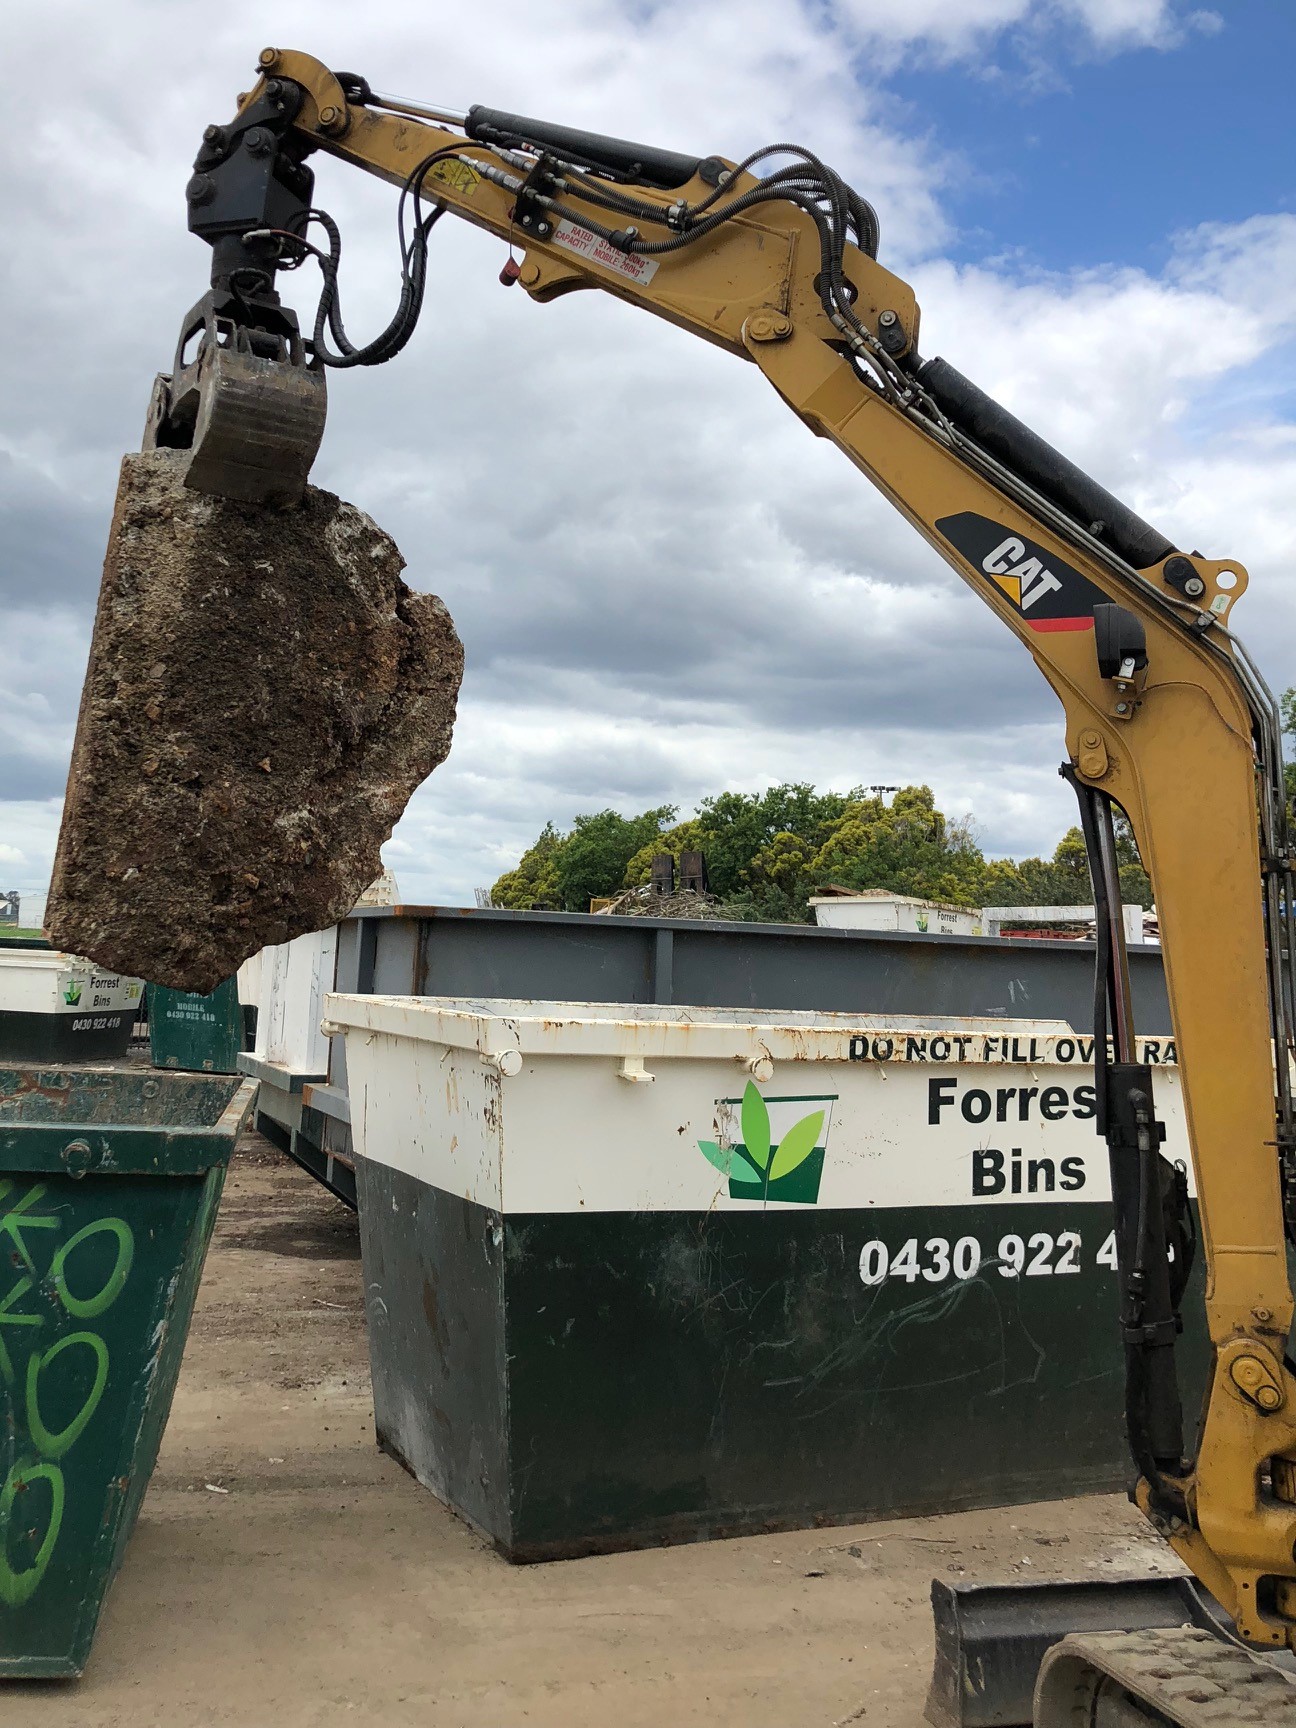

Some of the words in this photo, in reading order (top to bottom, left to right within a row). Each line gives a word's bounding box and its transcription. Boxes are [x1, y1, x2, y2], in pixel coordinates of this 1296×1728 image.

[555, 231, 589, 250] CAPACITY
[571, 226, 593, 242] RATED
[982, 537, 1063, 611] CAT
[937, 910, 958, 923] Forrest
[90, 976, 120, 989] Forrest
[93, 995, 111, 1007] Bins
[72, 1019, 92, 1031] 0430
[93, 1017, 107, 1029] 922
[106, 1017, 121, 1029] 418
[849, 1035, 894, 1061] DO
[906, 1037, 972, 1061] NOT
[983, 1037, 1045, 1062] FILL
[1055, 1039, 1115, 1064] OVE
[928, 1077, 1098, 1126] Forres
[972, 1148, 1086, 1197] Bins
[859, 1236, 982, 1286] 0430
[998, 1231, 1082, 1279] 922
